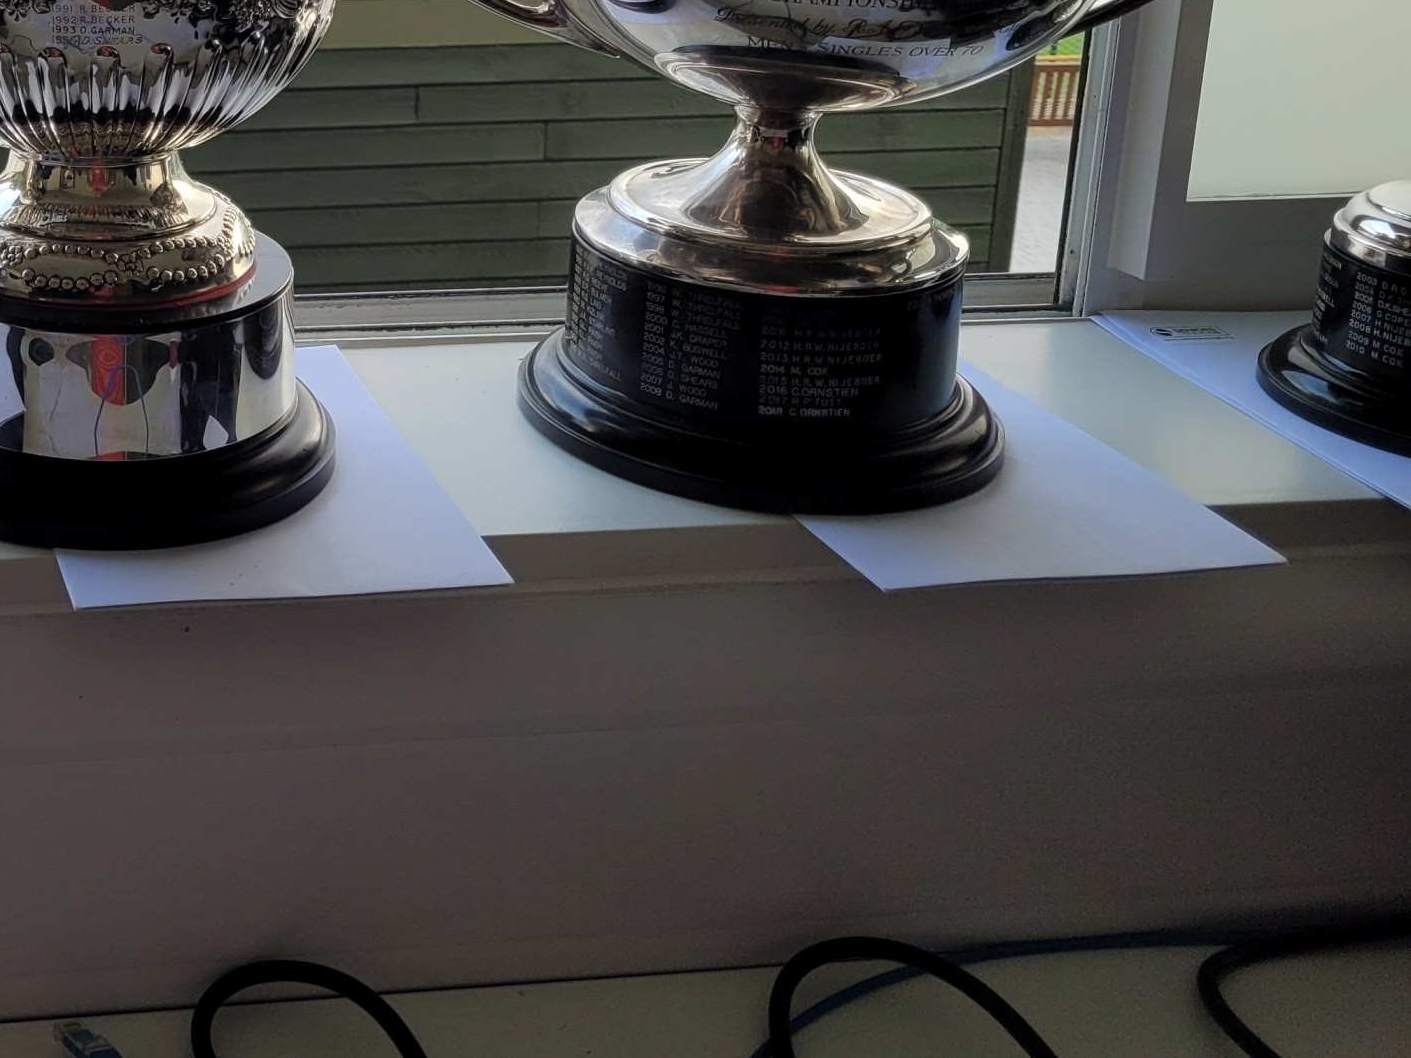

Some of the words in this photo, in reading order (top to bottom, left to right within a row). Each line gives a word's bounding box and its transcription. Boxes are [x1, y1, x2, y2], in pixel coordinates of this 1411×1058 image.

[52, 16, 76, 24] 1992
[52, 26, 76, 34] 1993
[817, 42, 903, 57] SINGLES
[908, 46, 958, 58] OVER
[961, 45, 984, 56] 70
[1357, 272, 1378, 285] 2003
[646, 291, 666, 303] 1997
[687, 303, 743, 319] THRELFALL
[1353, 301, 1372, 314] 2006
[645, 302, 665, 314] 1998
[687, 313, 742, 331] THRELFALL
[1351, 310, 1371, 322] 2007
[1375, 319, 1411, 336] H.NIJEB
[645, 313, 668, 325] 2000
[685, 323, 728, 338] HASSELL
[1349, 319, 1371, 334] 2008
[1373, 329, 1411, 347] H.NIJEB
[644, 323, 664, 334] 2001
[689, 334, 728, 348] DRAPER
[1349, 330, 1369, 345] 2009
[643, 333, 665, 345] 2002
[683, 343, 728, 359] BUSWELL
[760, 340, 789, 350] 2012
[1346, 341, 1365, 354] 2010
[642, 343, 665, 355] 2004
[690, 355, 718, 367] WOOD
[760, 352, 789, 363] 2013
[641, 353, 664, 365] 2005
[682, 364, 721, 379] GARMAN
[760, 365, 785, 374] 2014
[807, 367, 829, 376] COX
[640, 372, 663, 385] 2007
[679, 384, 707, 397] WOOD
[681, 373, 718, 388] SHEARS
[760, 375, 787, 385] 2015
[639, 382, 662, 396] 2008
[679, 394, 719, 410] GARMAN
[759, 386, 787, 395] 2016
